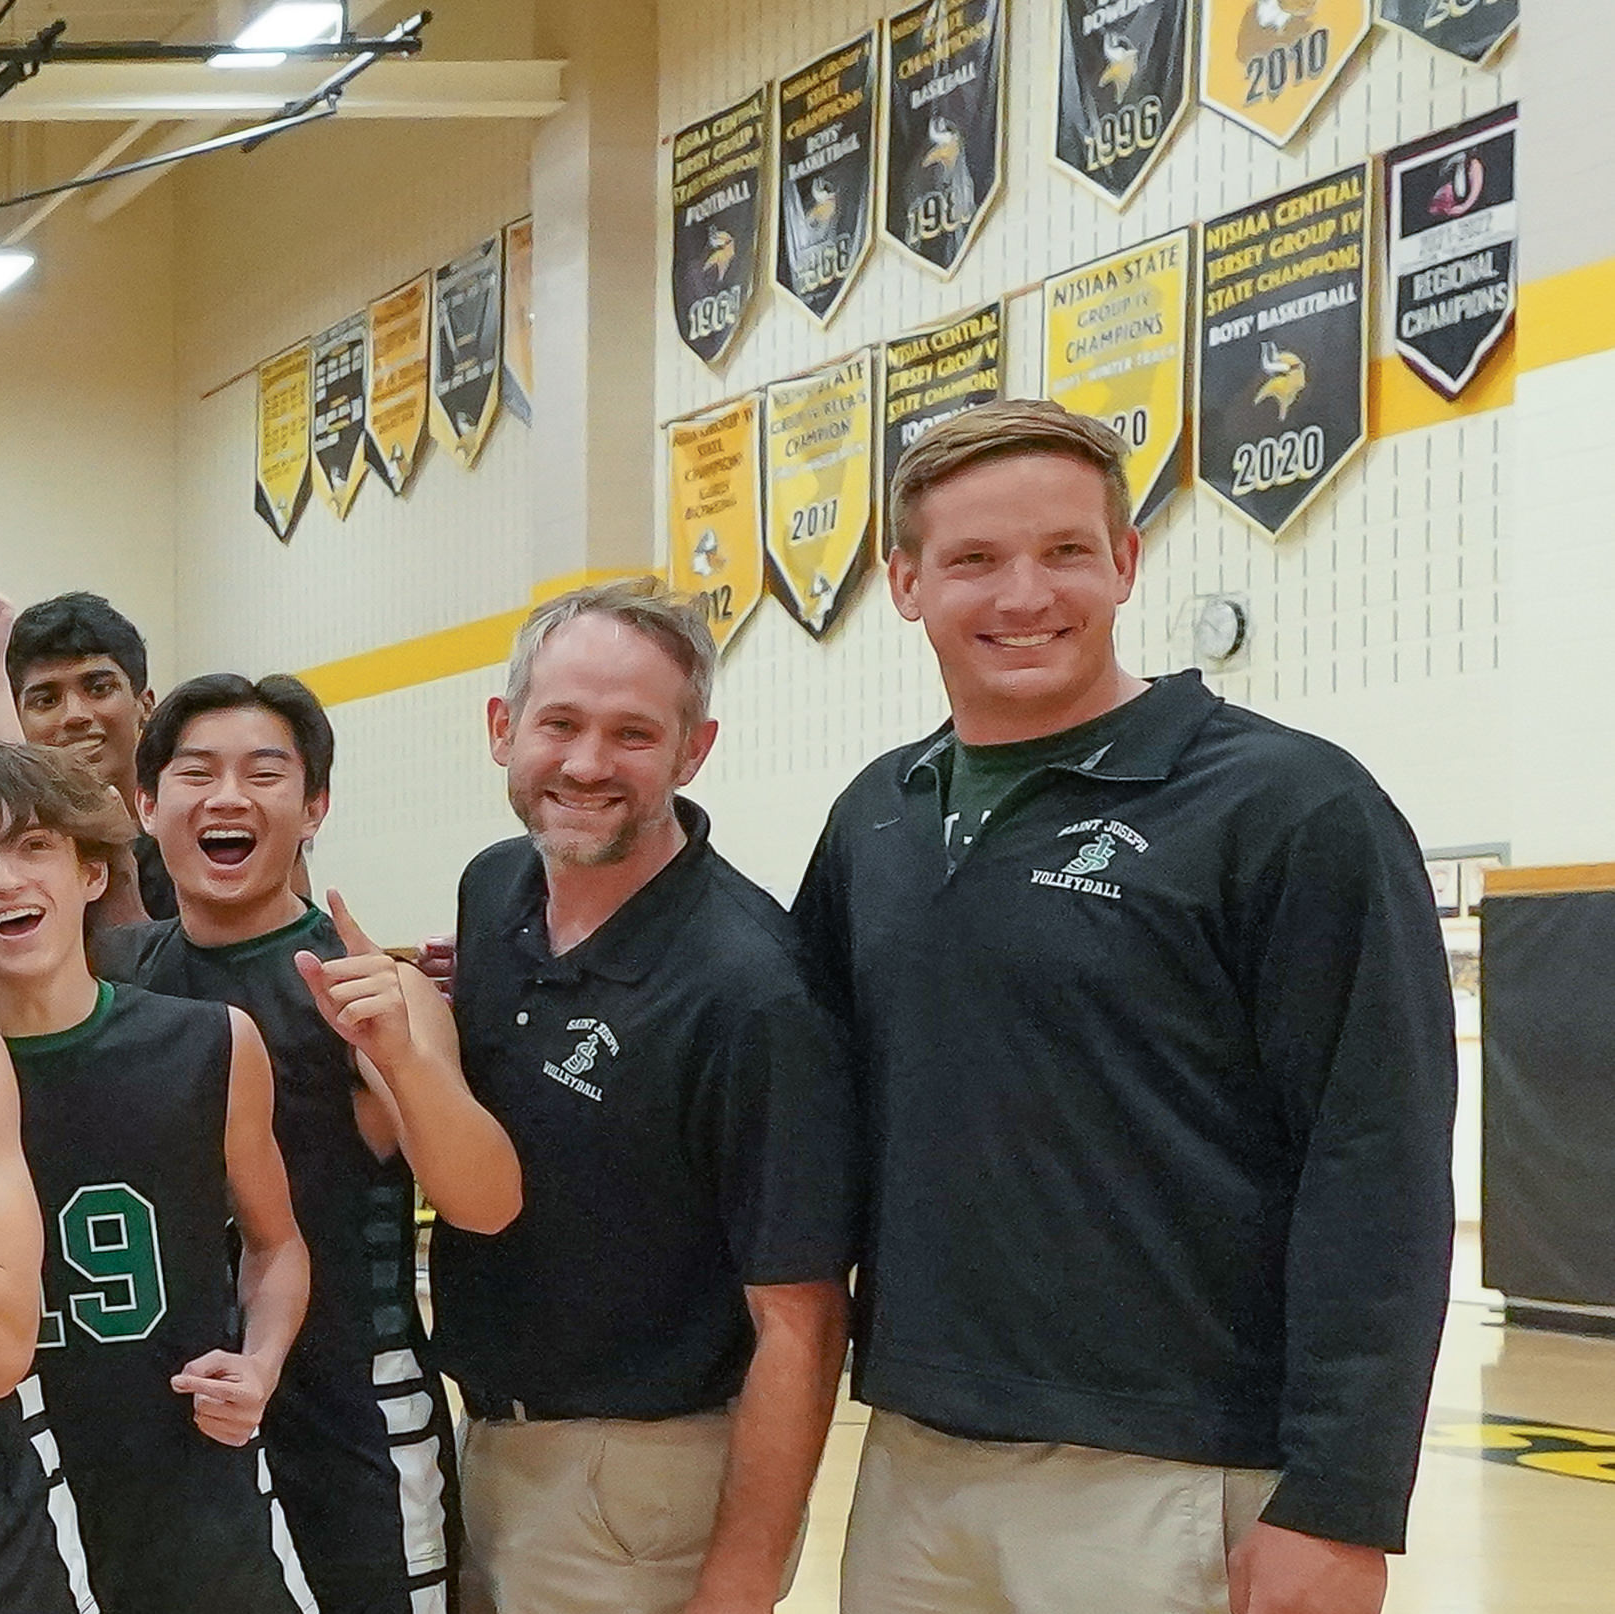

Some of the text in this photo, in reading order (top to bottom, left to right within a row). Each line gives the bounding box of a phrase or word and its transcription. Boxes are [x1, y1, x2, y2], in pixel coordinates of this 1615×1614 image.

[1244, 28, 1329, 107] 2010
[1085, 95, 1163, 171] 1996
[1206, 174, 1363, 253] NJSIAA CENTRAL
[1053, 244, 1180, 308] NJSIAA STATE
[1207, 206, 1363, 286] JERSEY GROUP IV
[1207, 243, 1361, 318] STATE CHAMPIONS
[1256, 281, 1358, 332] BASKETBALL
[1400, 281, 1509, 339] CHAMPIONS
[1065, 313, 1164, 364] CHAMPIONS
[1231, 423, 1326, 497] 2020
[1103, 819, 1150, 854] JOSEPH
[1030, 868, 1122, 900] VOLLEYBALL
[542, 1060, 604, 1102] VOLLEYBALL
